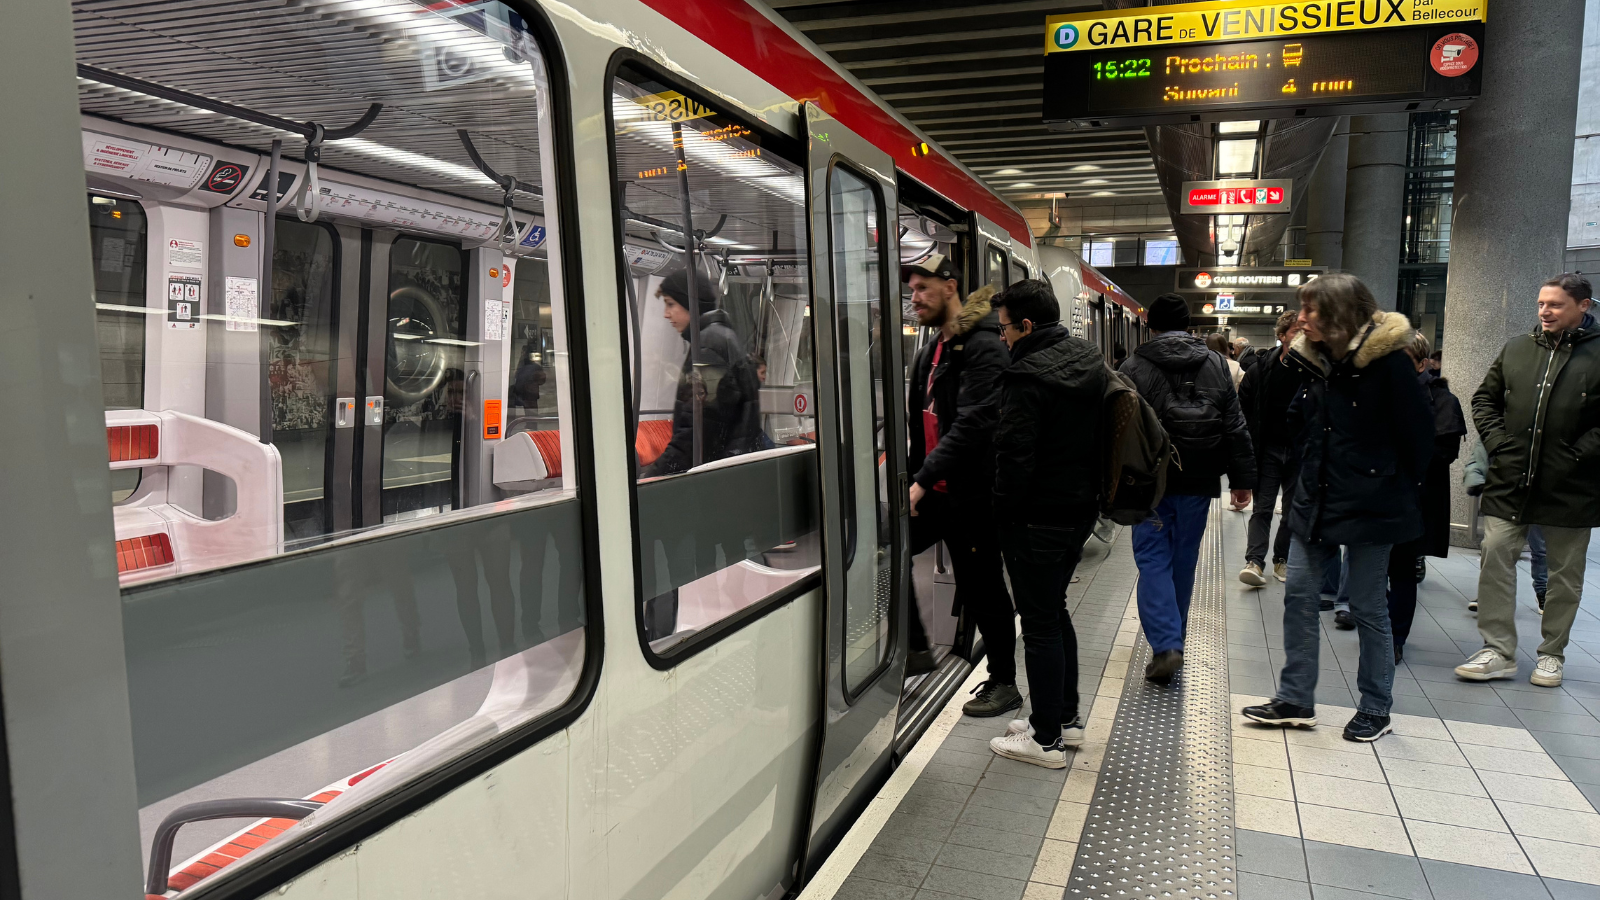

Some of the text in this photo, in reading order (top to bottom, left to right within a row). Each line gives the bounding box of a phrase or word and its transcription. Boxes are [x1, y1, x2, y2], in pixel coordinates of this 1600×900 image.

[1059, 0, 1406, 46] D GARE DE VENISSIEUX
[1412, 7, 1479, 21] Bellecour
[1093, 58, 1151, 80] 15:22
[1165, 51, 1258, 75] Prochain
[1213, 275, 1237, 284] GARE
[1238, 275, 1283, 284] ROUTIERE
